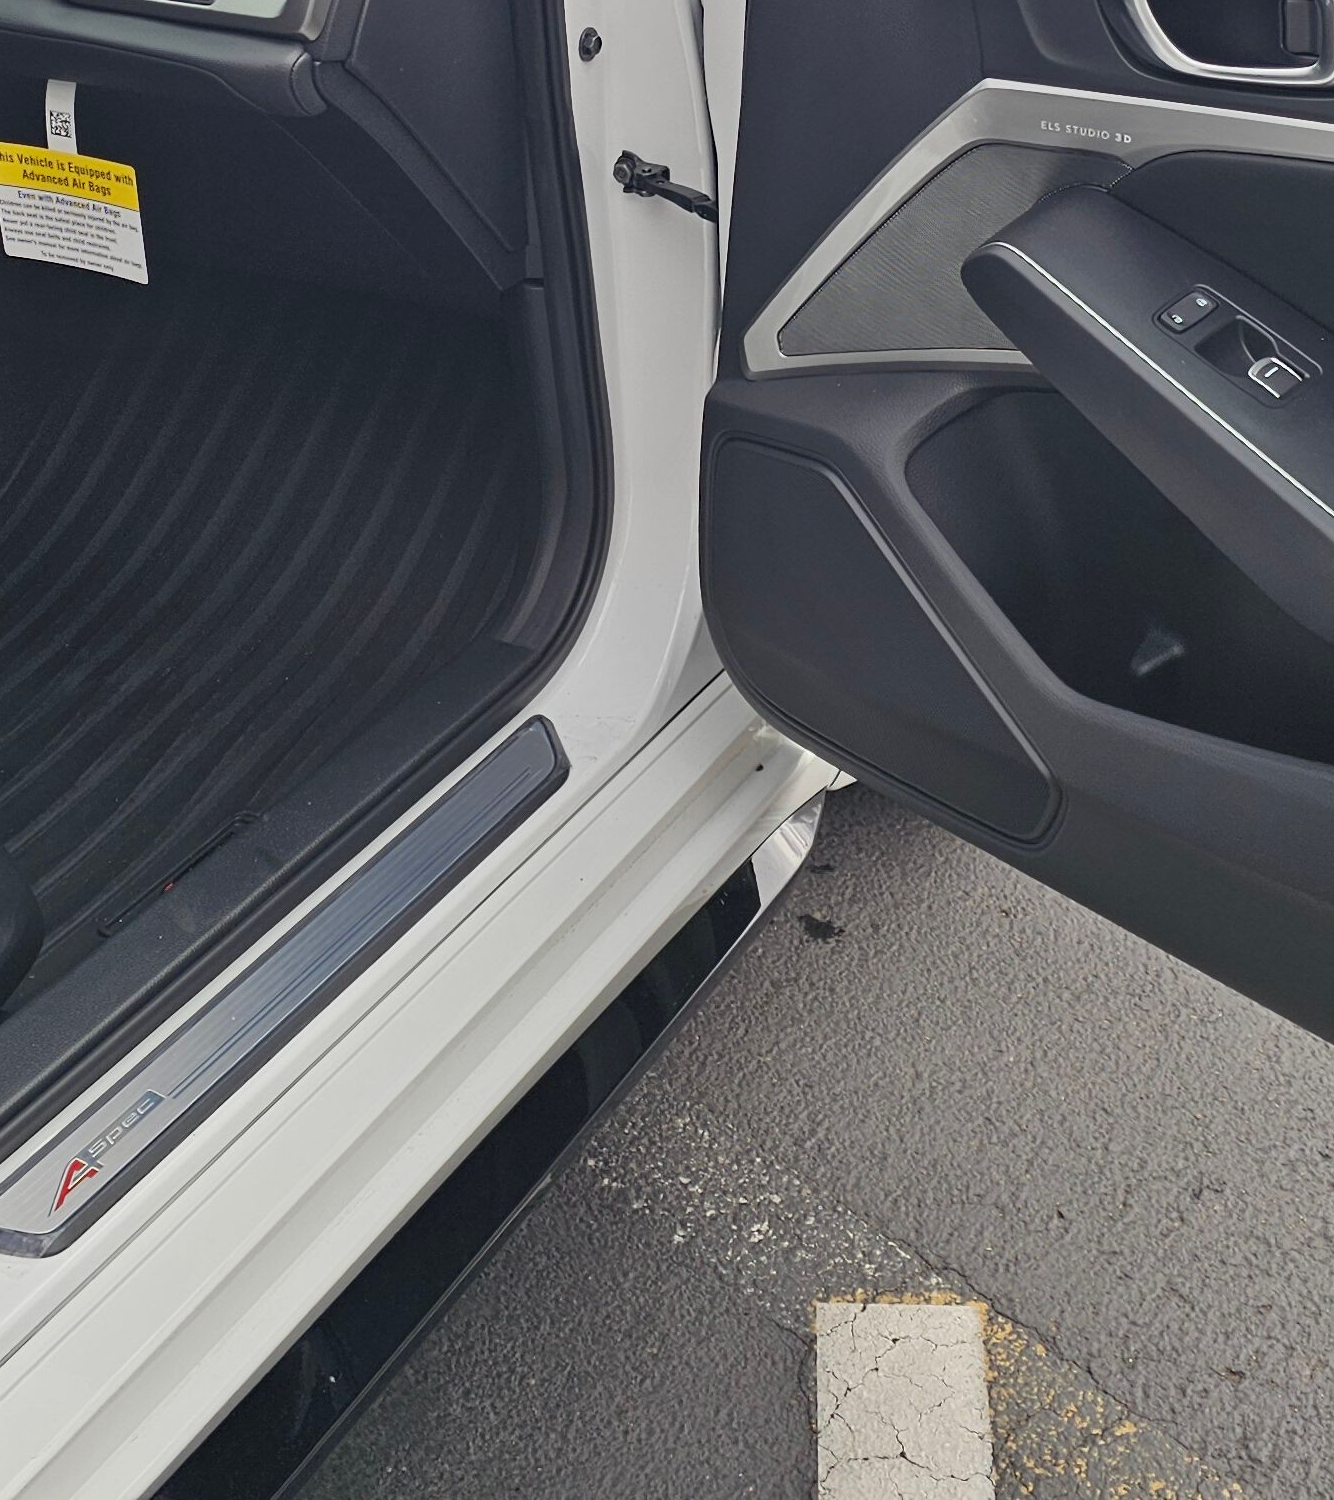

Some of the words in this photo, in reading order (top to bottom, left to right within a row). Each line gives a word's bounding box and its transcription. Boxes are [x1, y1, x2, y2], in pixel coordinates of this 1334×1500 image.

[1040, 120, 1061, 132] ELS
[1065, 124, 1110, 140] STUDIO
[1114, 132, 1132, 143] 3D
[17, 153, 54, 169] Vehicle
[56, 159, 66, 171] is
[68, 162, 112, 181] Equipped
[114, 173, 134, 187] with
[22, 169, 69, 187] Advanced
[72, 177, 86, 190] Air
[88, 181, 112, 197] Bags
[17, 190, 36, 200] Even
[55, 196, 90, 211] Advanced
